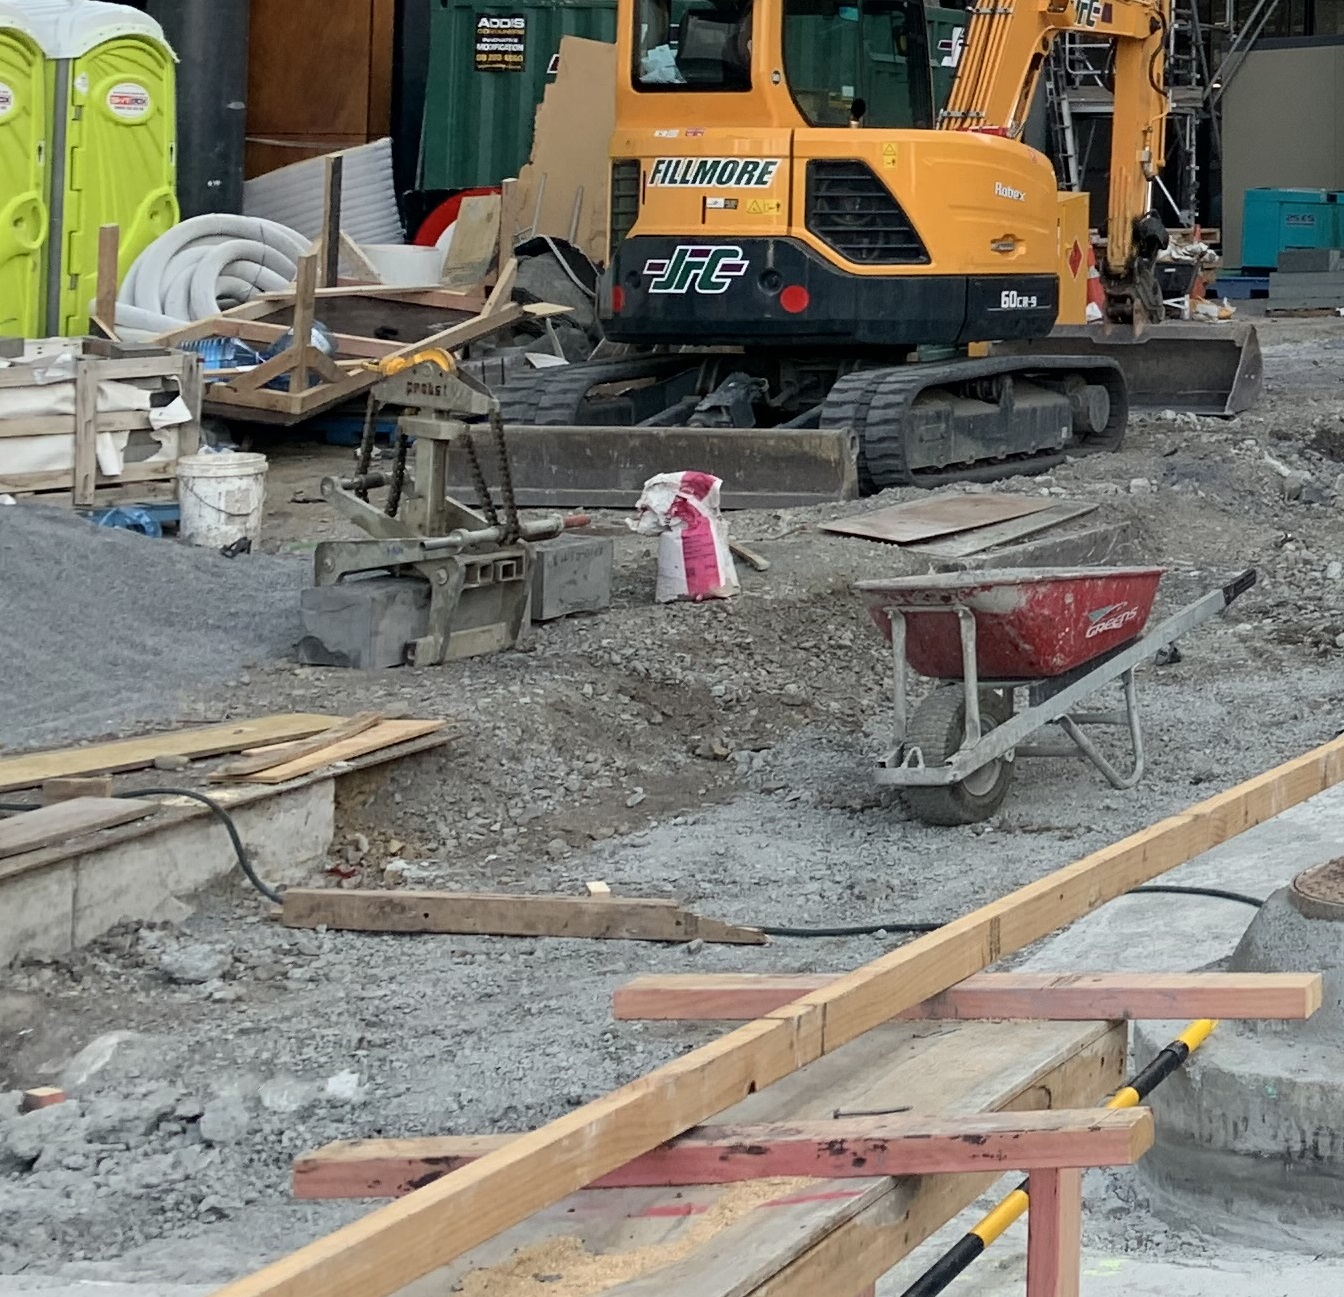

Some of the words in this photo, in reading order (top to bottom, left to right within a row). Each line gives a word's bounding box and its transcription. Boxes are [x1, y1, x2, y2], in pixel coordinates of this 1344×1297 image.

[477, 17, 525, 29] ADDIS
[648, 158, 781, 188] FILLMORE
[995, 181, 1026, 202] Robex
[647, 245, 746, 294] JFC
